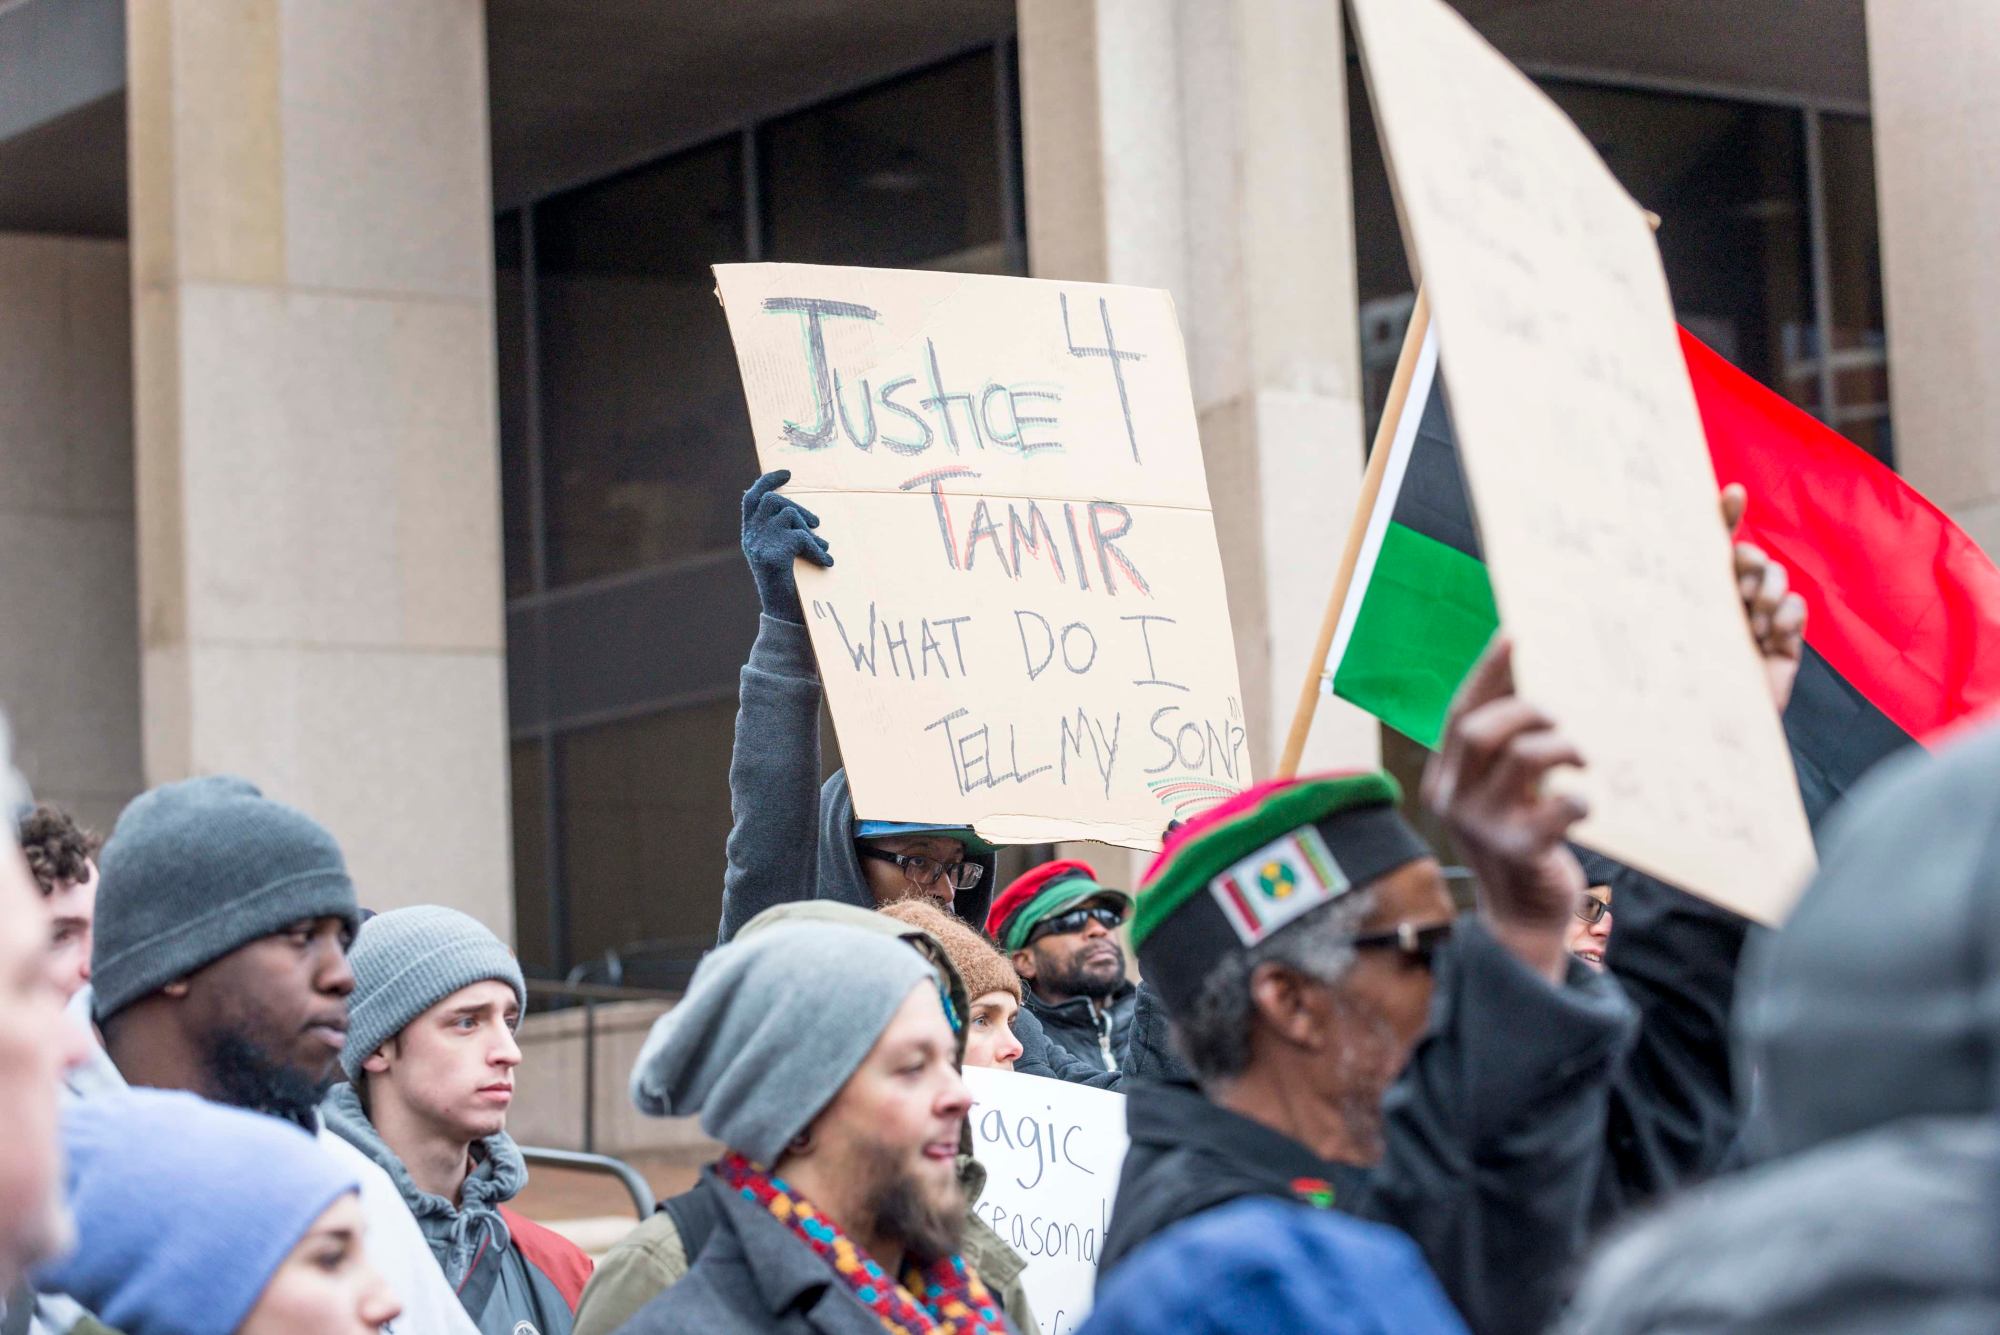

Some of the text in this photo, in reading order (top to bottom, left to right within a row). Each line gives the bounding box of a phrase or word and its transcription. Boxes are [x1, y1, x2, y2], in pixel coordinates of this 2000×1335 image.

[1058, 291, 1147, 466] 4
[898, 465, 1155, 600] TAMIR
[1014, 610, 1097, 681] DO
[1120, 614, 1190, 692] I
[923, 706, 1053, 797] TELL
[1061, 706, 1121, 800] MY
[972, 1101, 1096, 1190] agic
